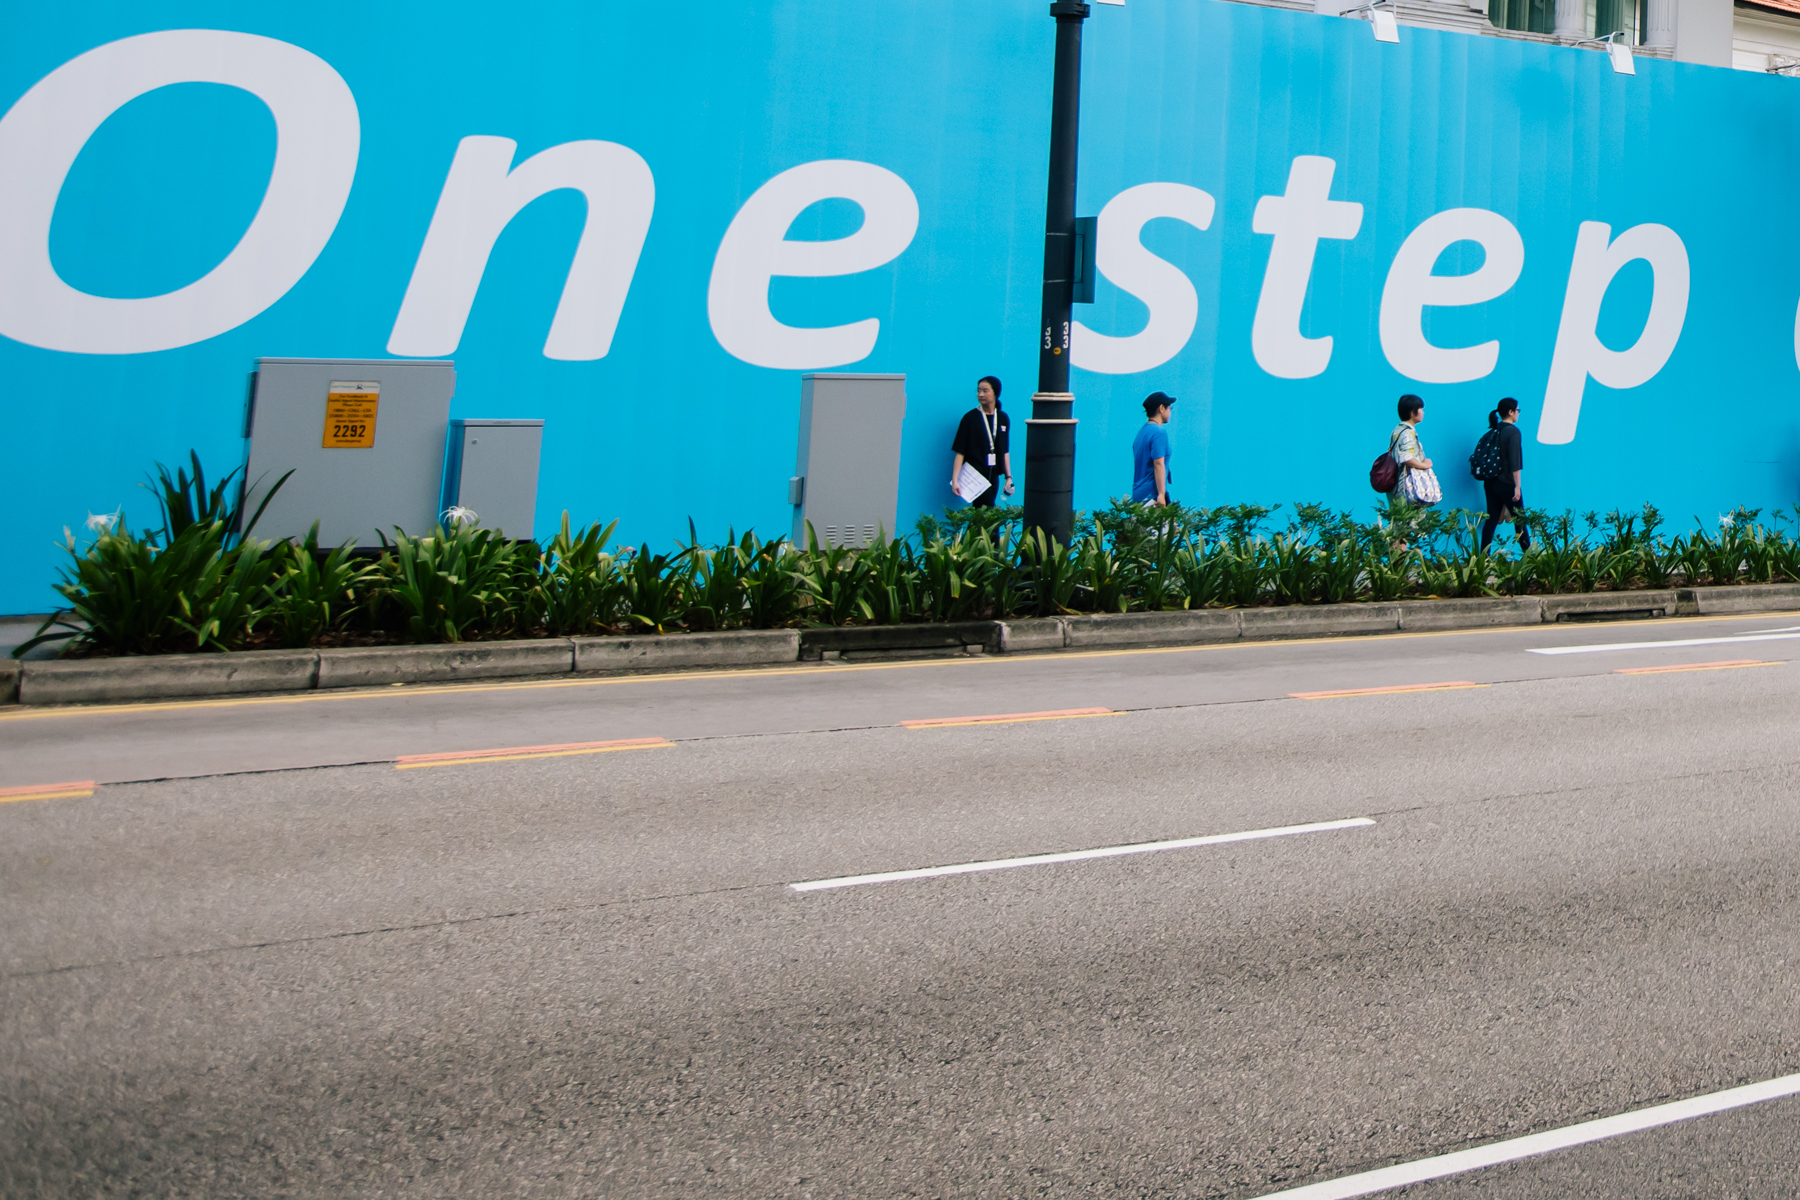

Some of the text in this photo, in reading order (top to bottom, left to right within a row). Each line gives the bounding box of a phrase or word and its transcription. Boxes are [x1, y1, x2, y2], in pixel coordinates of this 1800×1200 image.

[0, 28, 920, 371] One
[1069, 154, 1691, 445] step
[333, 424, 366, 438] 2292
